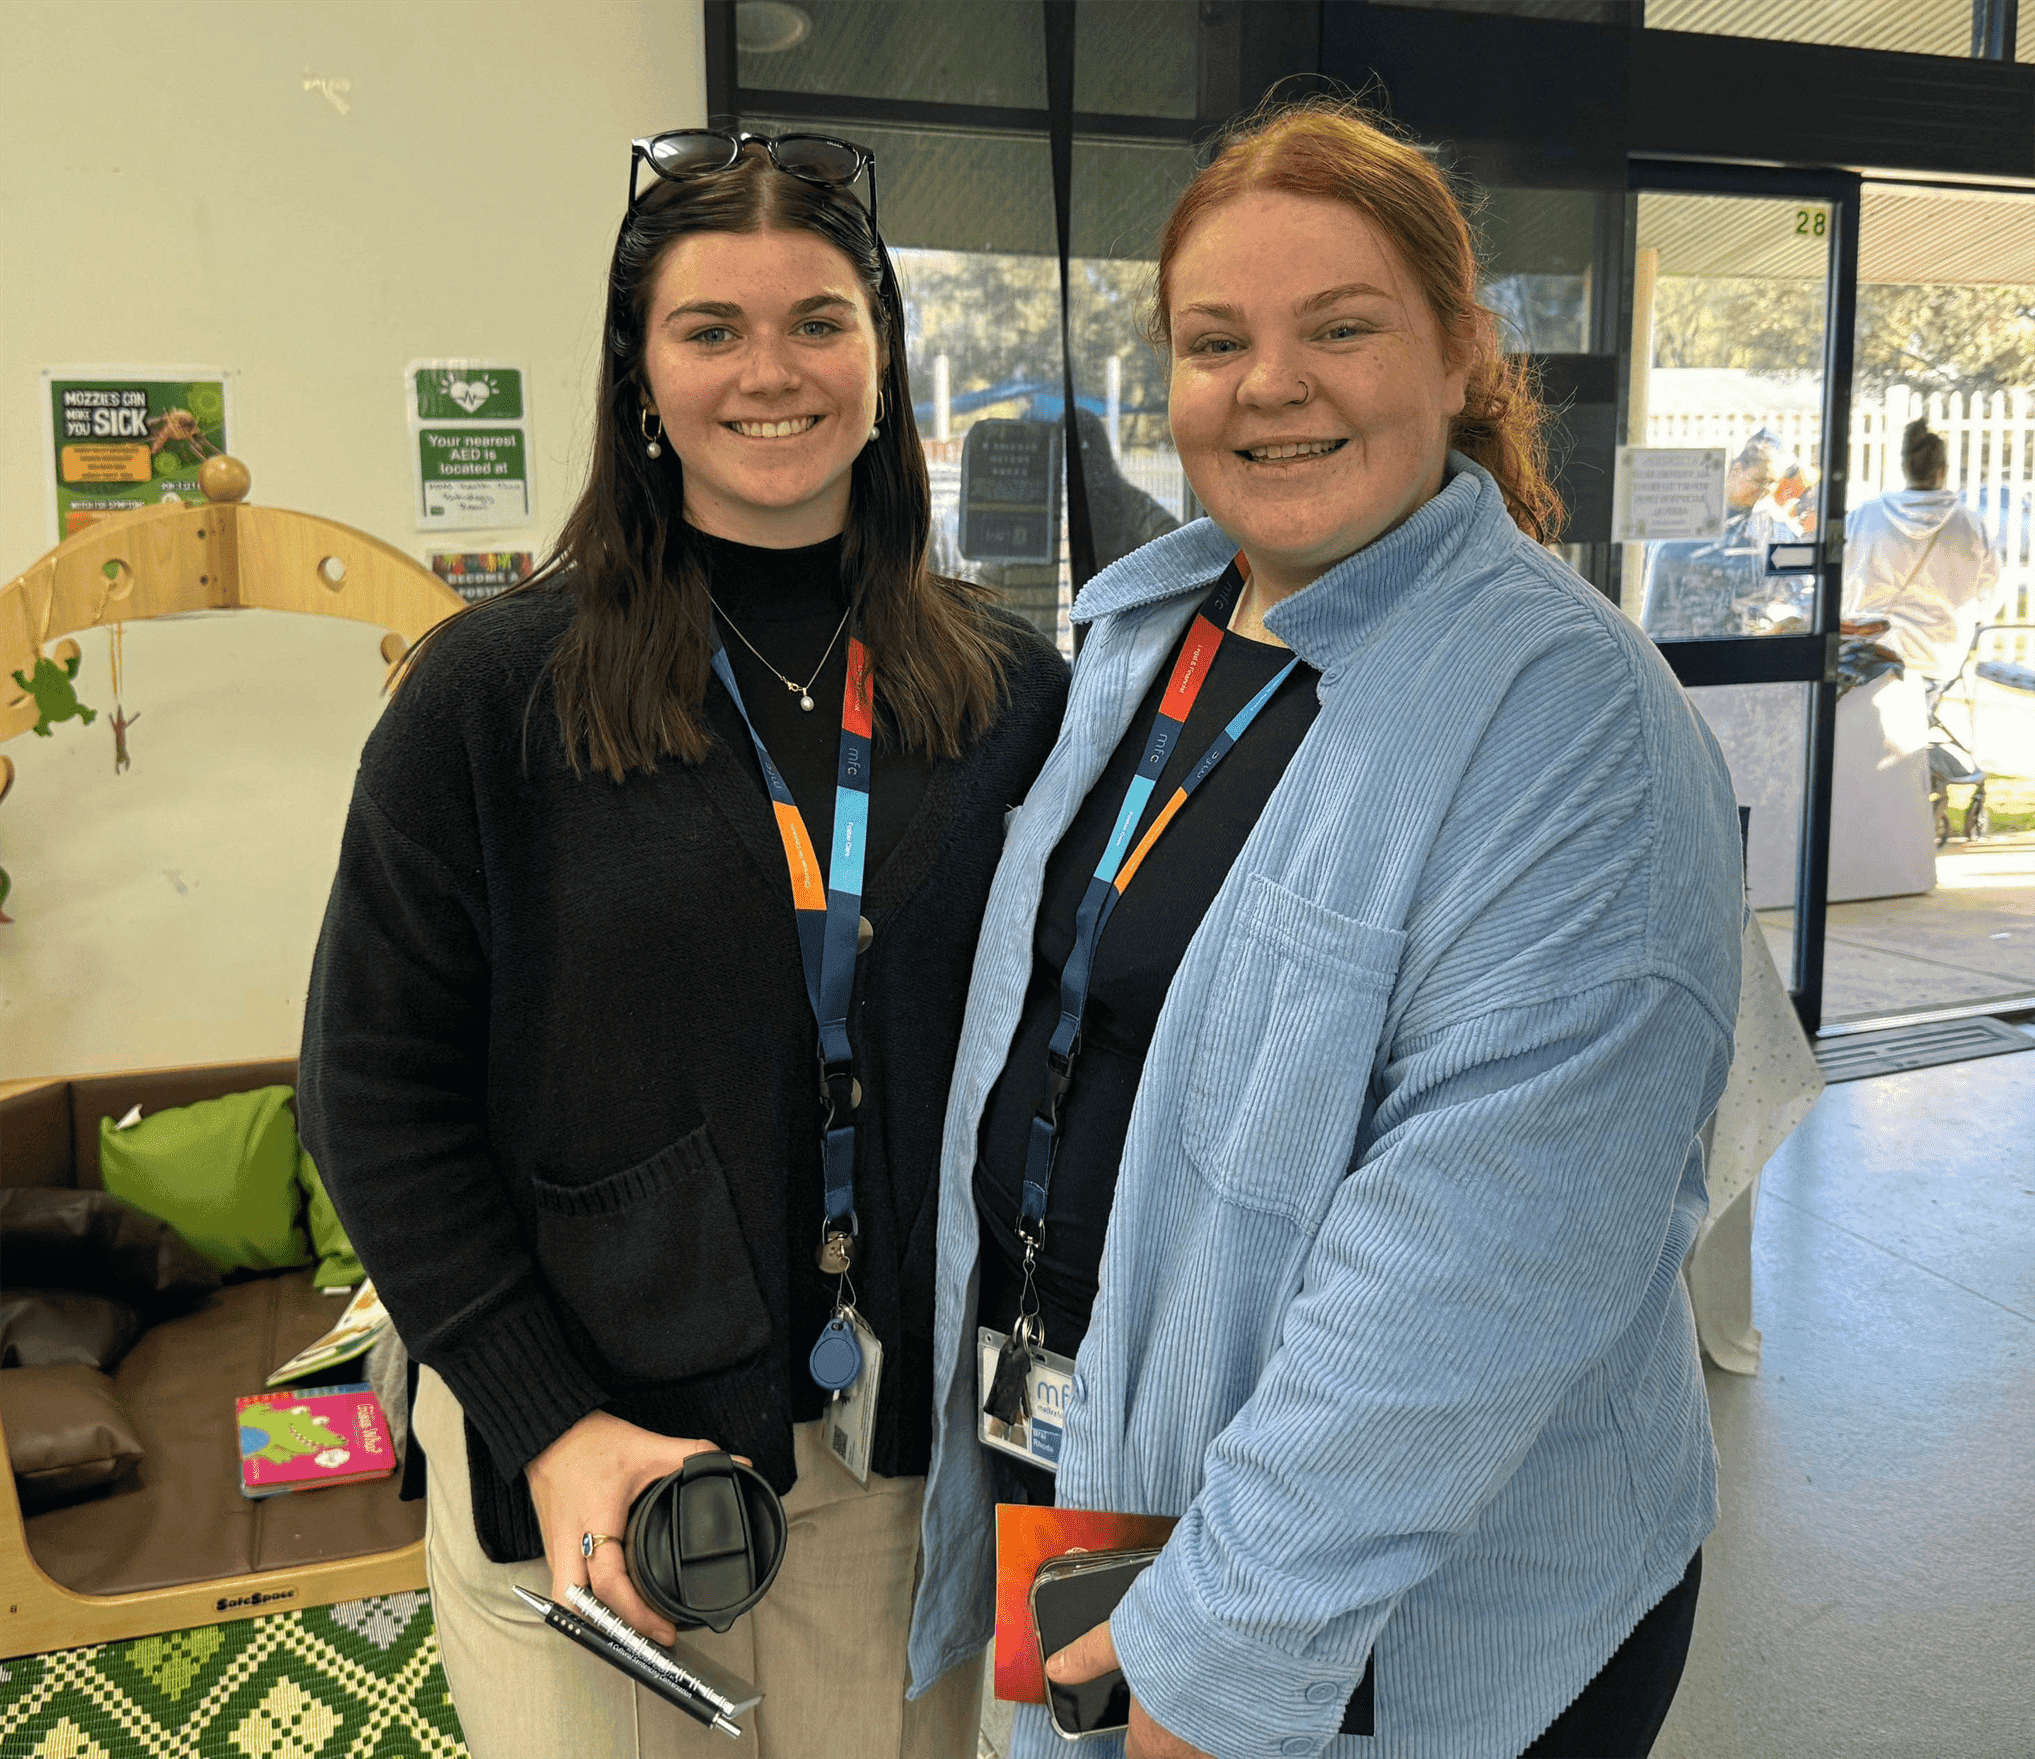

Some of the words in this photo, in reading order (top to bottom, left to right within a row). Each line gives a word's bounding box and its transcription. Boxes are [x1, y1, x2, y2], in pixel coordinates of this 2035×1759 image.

[1795, 208, 1827, 237] 28
[63, 390, 120, 406] MOZZIES
[121, 391, 146, 407] CAN
[65, 409, 91, 421] MAKE
[93, 407, 149, 436] SICK
[66, 422, 91, 436] YOU
[428, 433, 461, 447] Your
[464, 434, 516, 448] nearest
[450, 448, 481, 461] AED
[483, 448, 497, 461] is
[440, 462, 491, 475] located
[494, 461, 508, 475] at
[1149, 733, 1168, 763] mfc
[847, 747, 861, 775] mfc
[1037, 1381, 1070, 1409] mf
